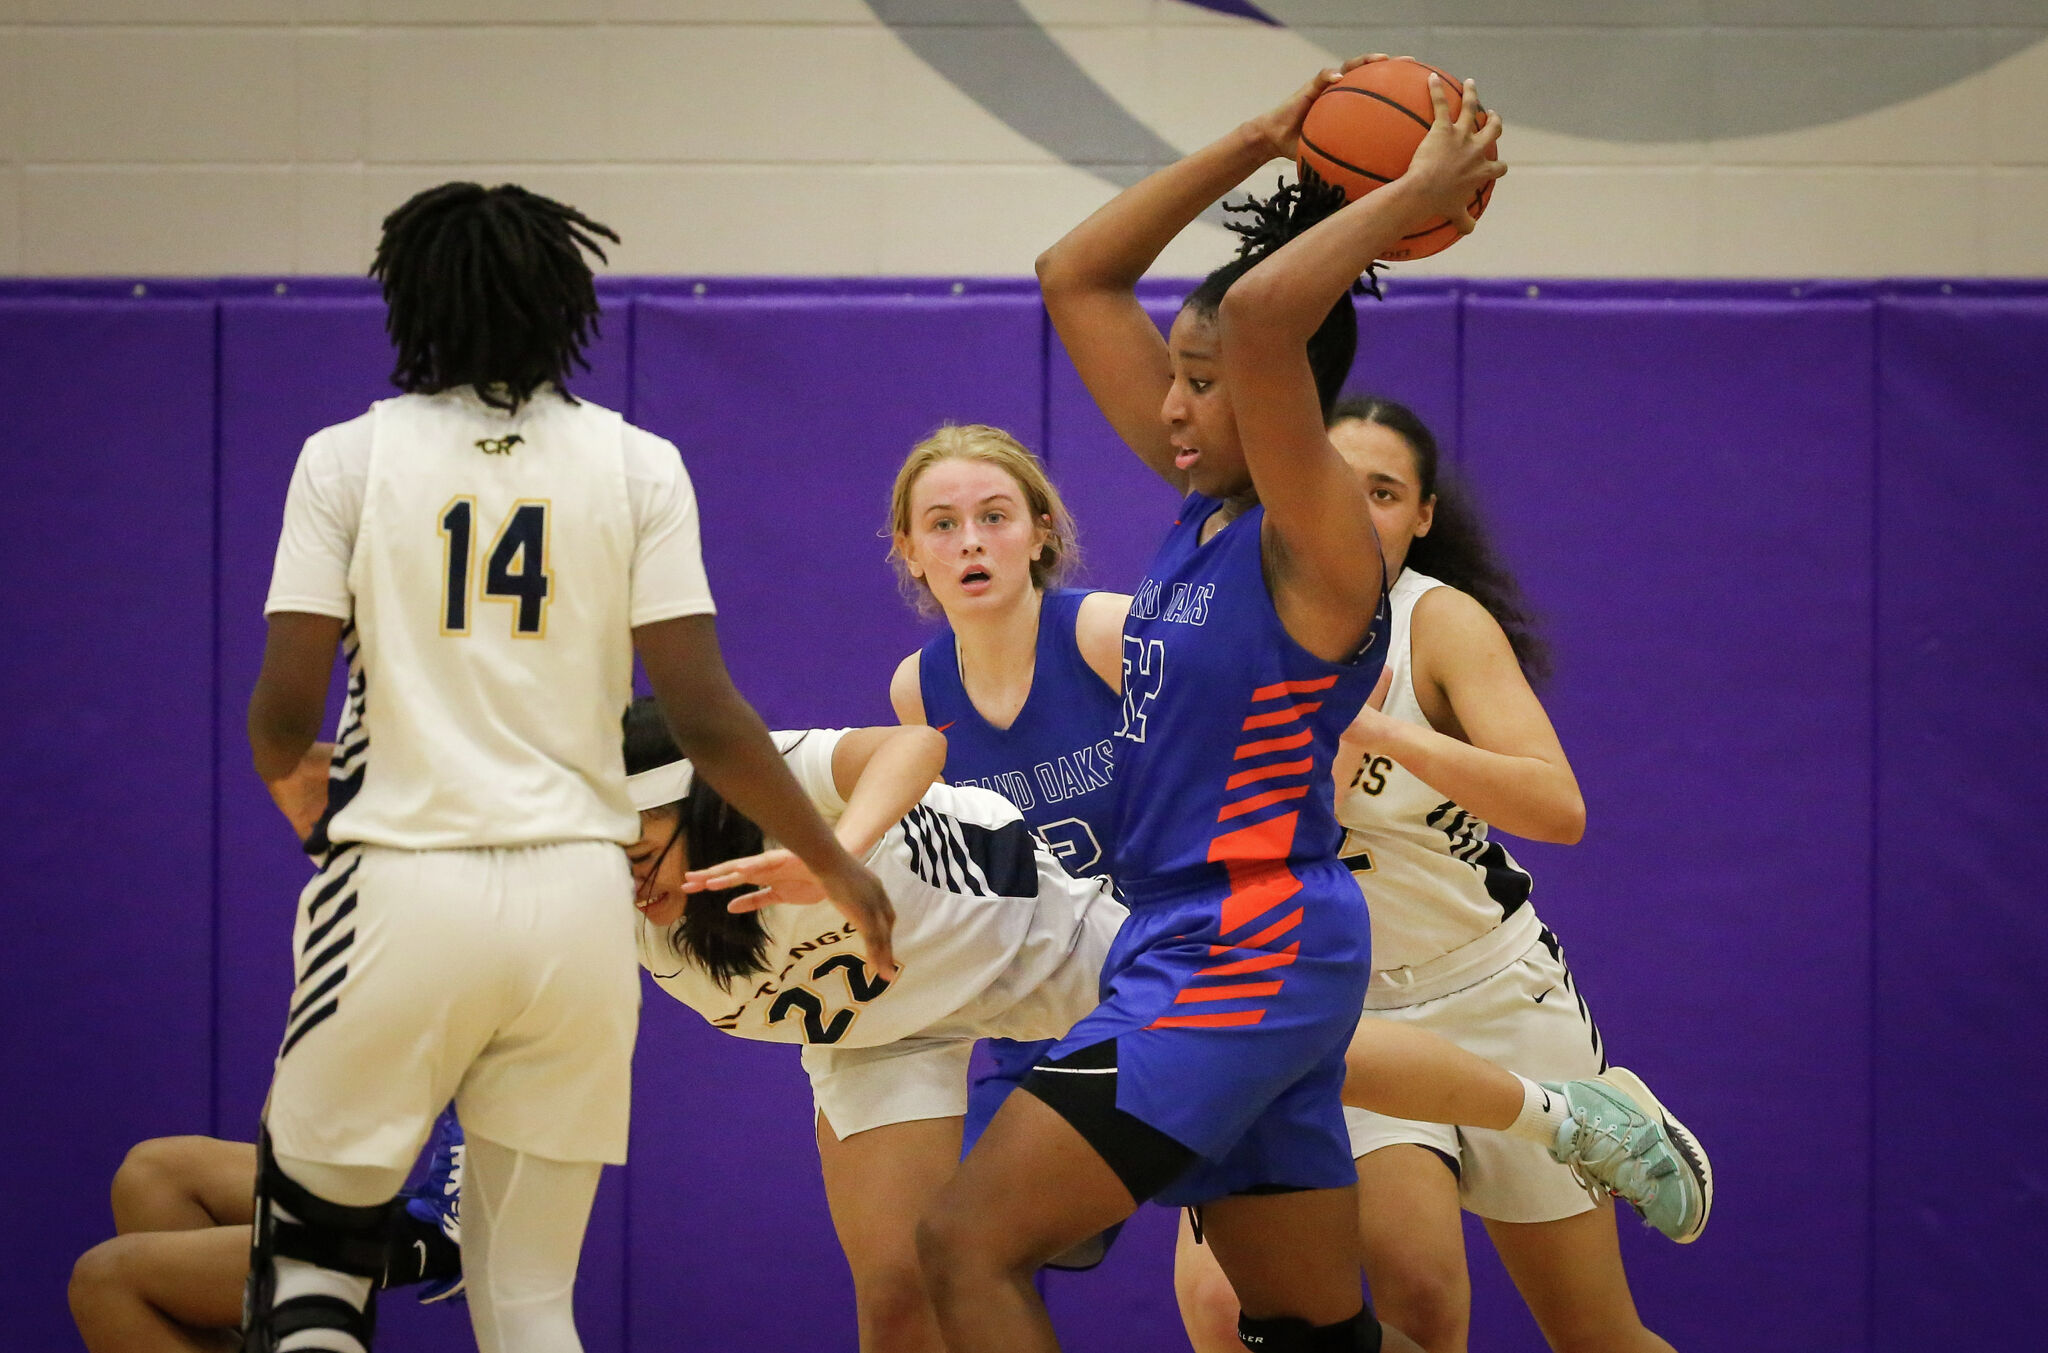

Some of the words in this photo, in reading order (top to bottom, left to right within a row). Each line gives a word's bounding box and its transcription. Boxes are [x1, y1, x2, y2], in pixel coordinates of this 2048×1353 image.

[437, 494, 555, 640] 14
[1034, 740, 1114, 803] OAKS
[765, 952, 905, 1043] 22
